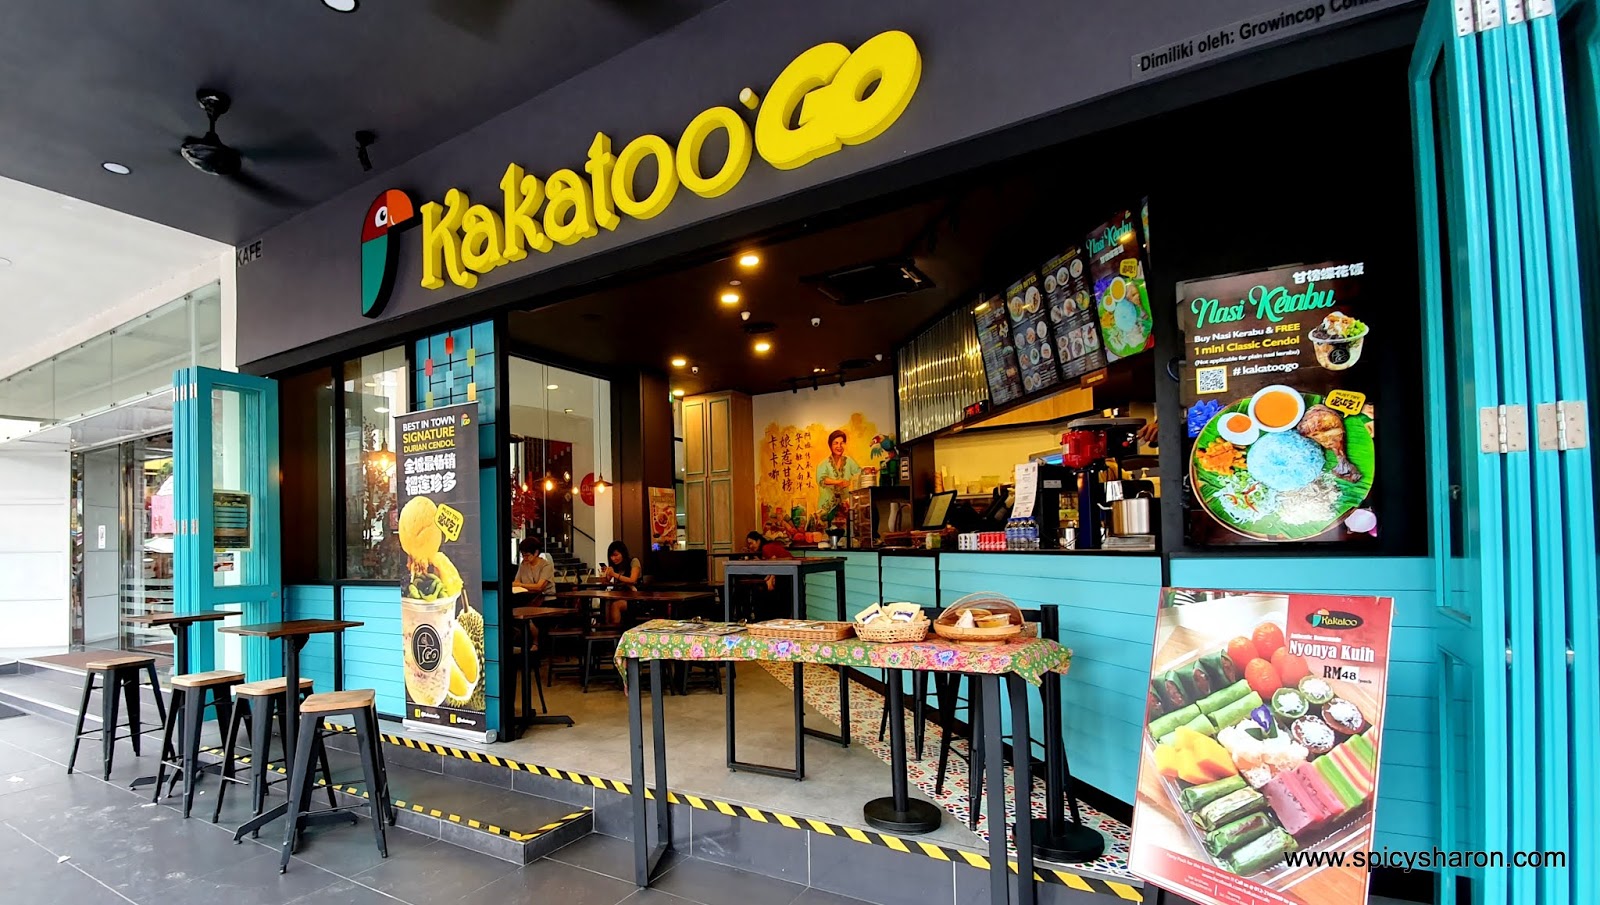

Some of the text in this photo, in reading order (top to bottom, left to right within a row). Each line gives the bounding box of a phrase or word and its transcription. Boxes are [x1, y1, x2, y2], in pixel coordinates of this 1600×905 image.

[1140, 42, 1193, 72] Dimiliki
[1198, 30, 1235, 53] oleh:
[1239, 4, 1325, 40] Growincop
[236, 240, 262, 266] KAFE
[1190, 282, 1337, 328] Nasi Kerabu
[1194, 323, 1300, 343] Buy Nasi Kerabu & FREE
[1194, 335, 1300, 355] 1 mini Classic Cendol
[402, 415, 455, 432] BEST IN TOWN
[402, 426, 455, 444] SIGNATURE
[403, 439, 455, 453] DURIAN CENDOL
[1288, 640, 1375, 663] Nyonya Kuih
